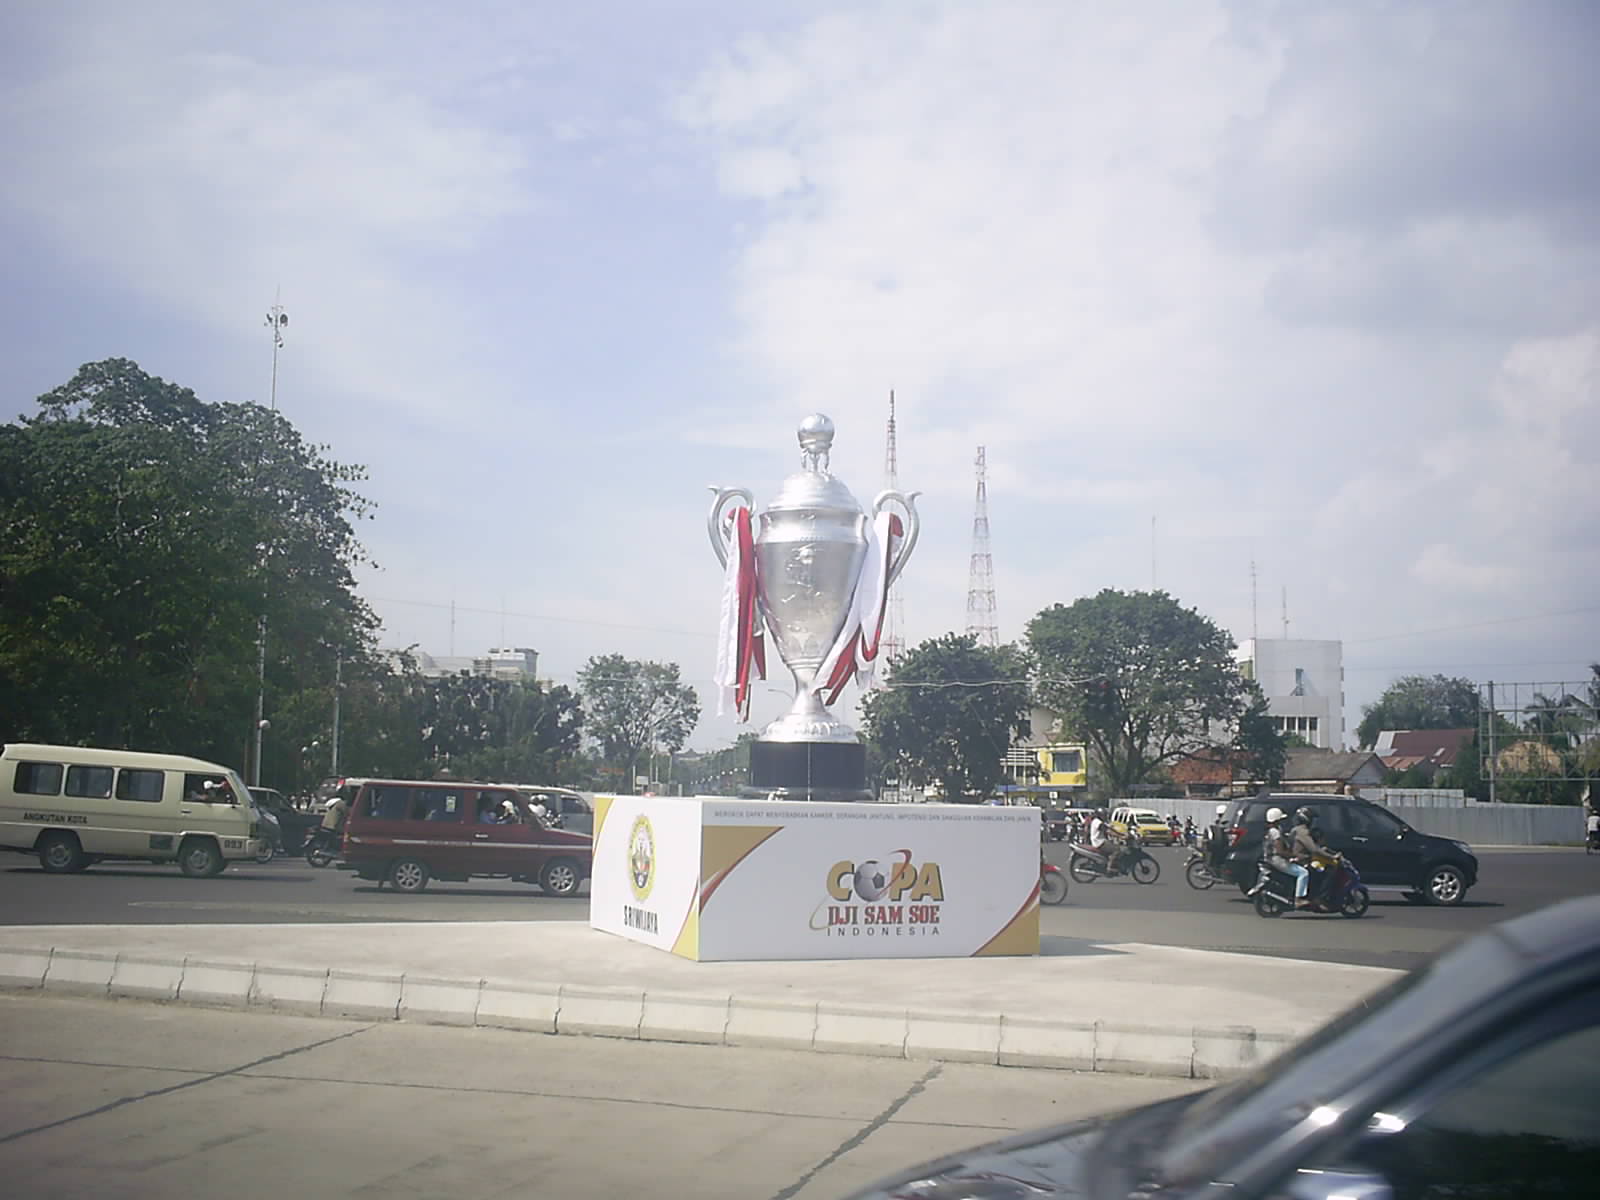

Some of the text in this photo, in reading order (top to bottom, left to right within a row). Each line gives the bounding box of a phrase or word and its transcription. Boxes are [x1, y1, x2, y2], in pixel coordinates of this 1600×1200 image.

[23, 812, 88, 825] ANGKUTAN KOTA
[826, 860, 944, 902] COPA
[623, 904, 659, 936] SRIWIJAYA
[827, 904, 940, 926] DJI SAM SOE
[827, 926, 940, 937] INDONESIA
